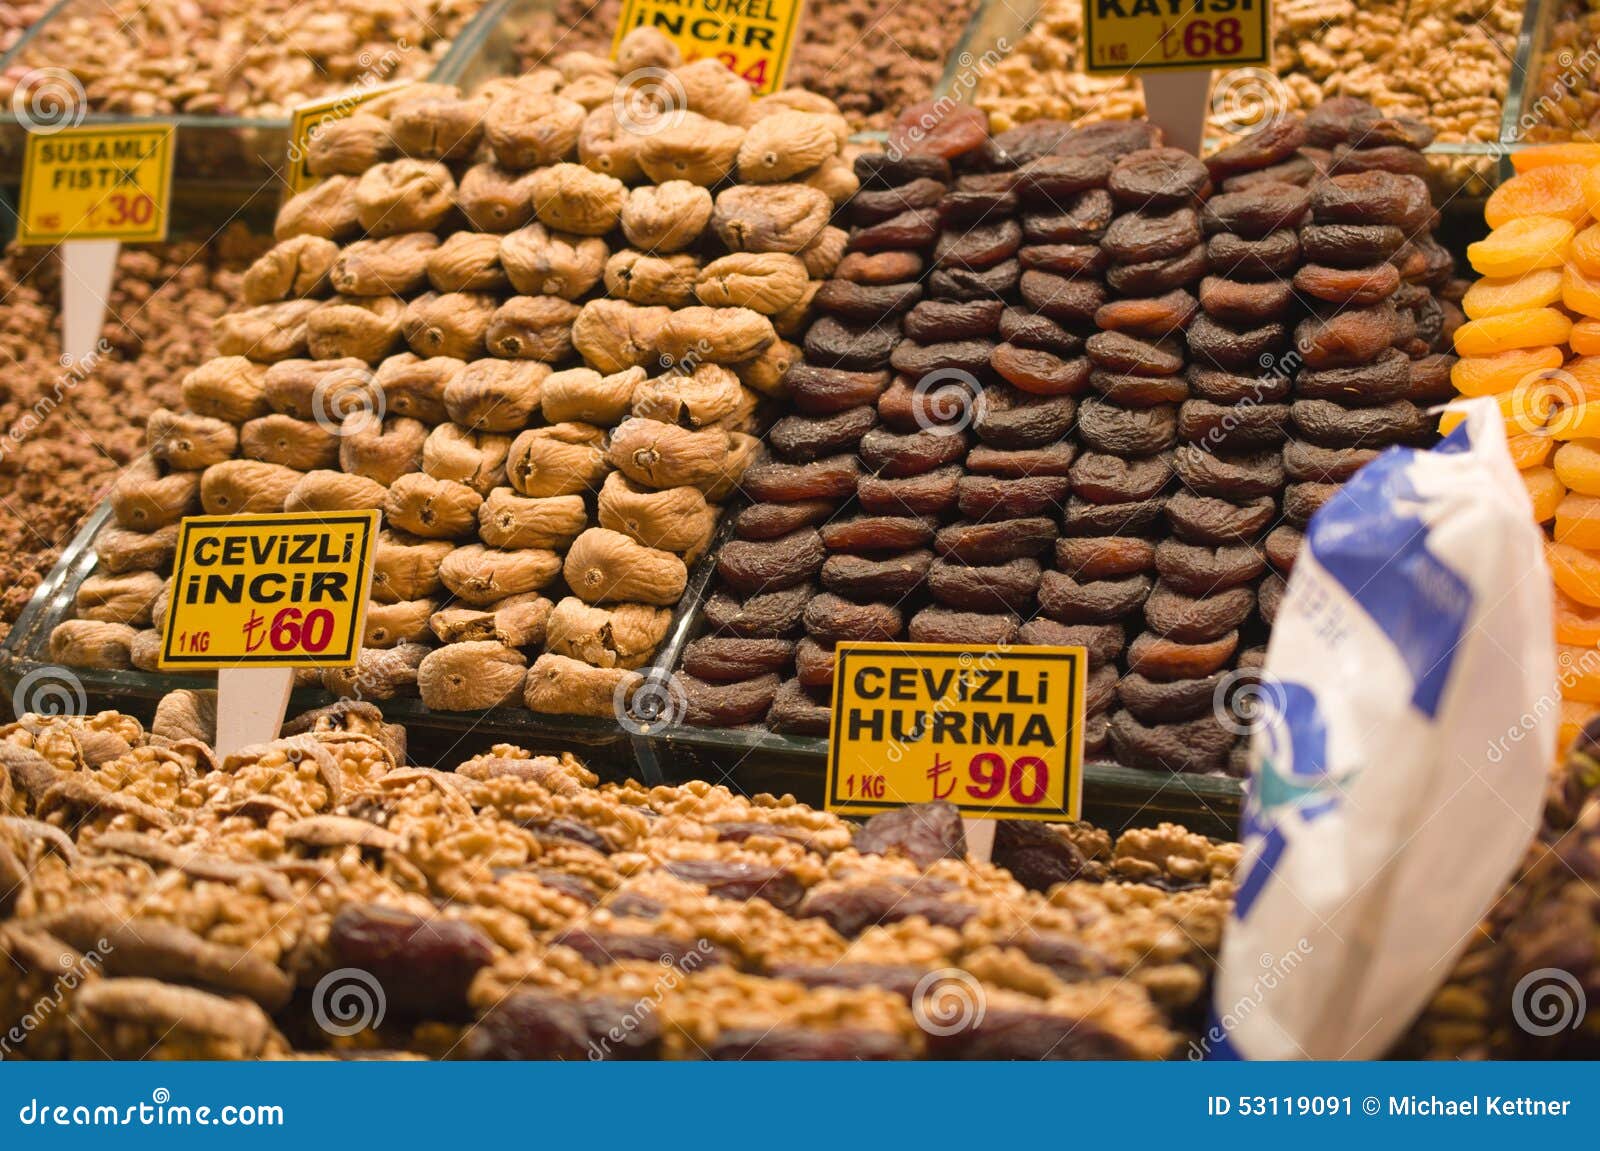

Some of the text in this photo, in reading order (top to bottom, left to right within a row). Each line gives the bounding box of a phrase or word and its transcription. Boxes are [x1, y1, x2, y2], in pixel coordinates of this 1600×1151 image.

[1109, 43, 1127, 61] KG
[52, 167, 140, 192] FISTIK
[180, 631, 210, 652] 1 KG
[848, 708, 1056, 747] HURMA
[847, 775, 885, 799] 1 KG
